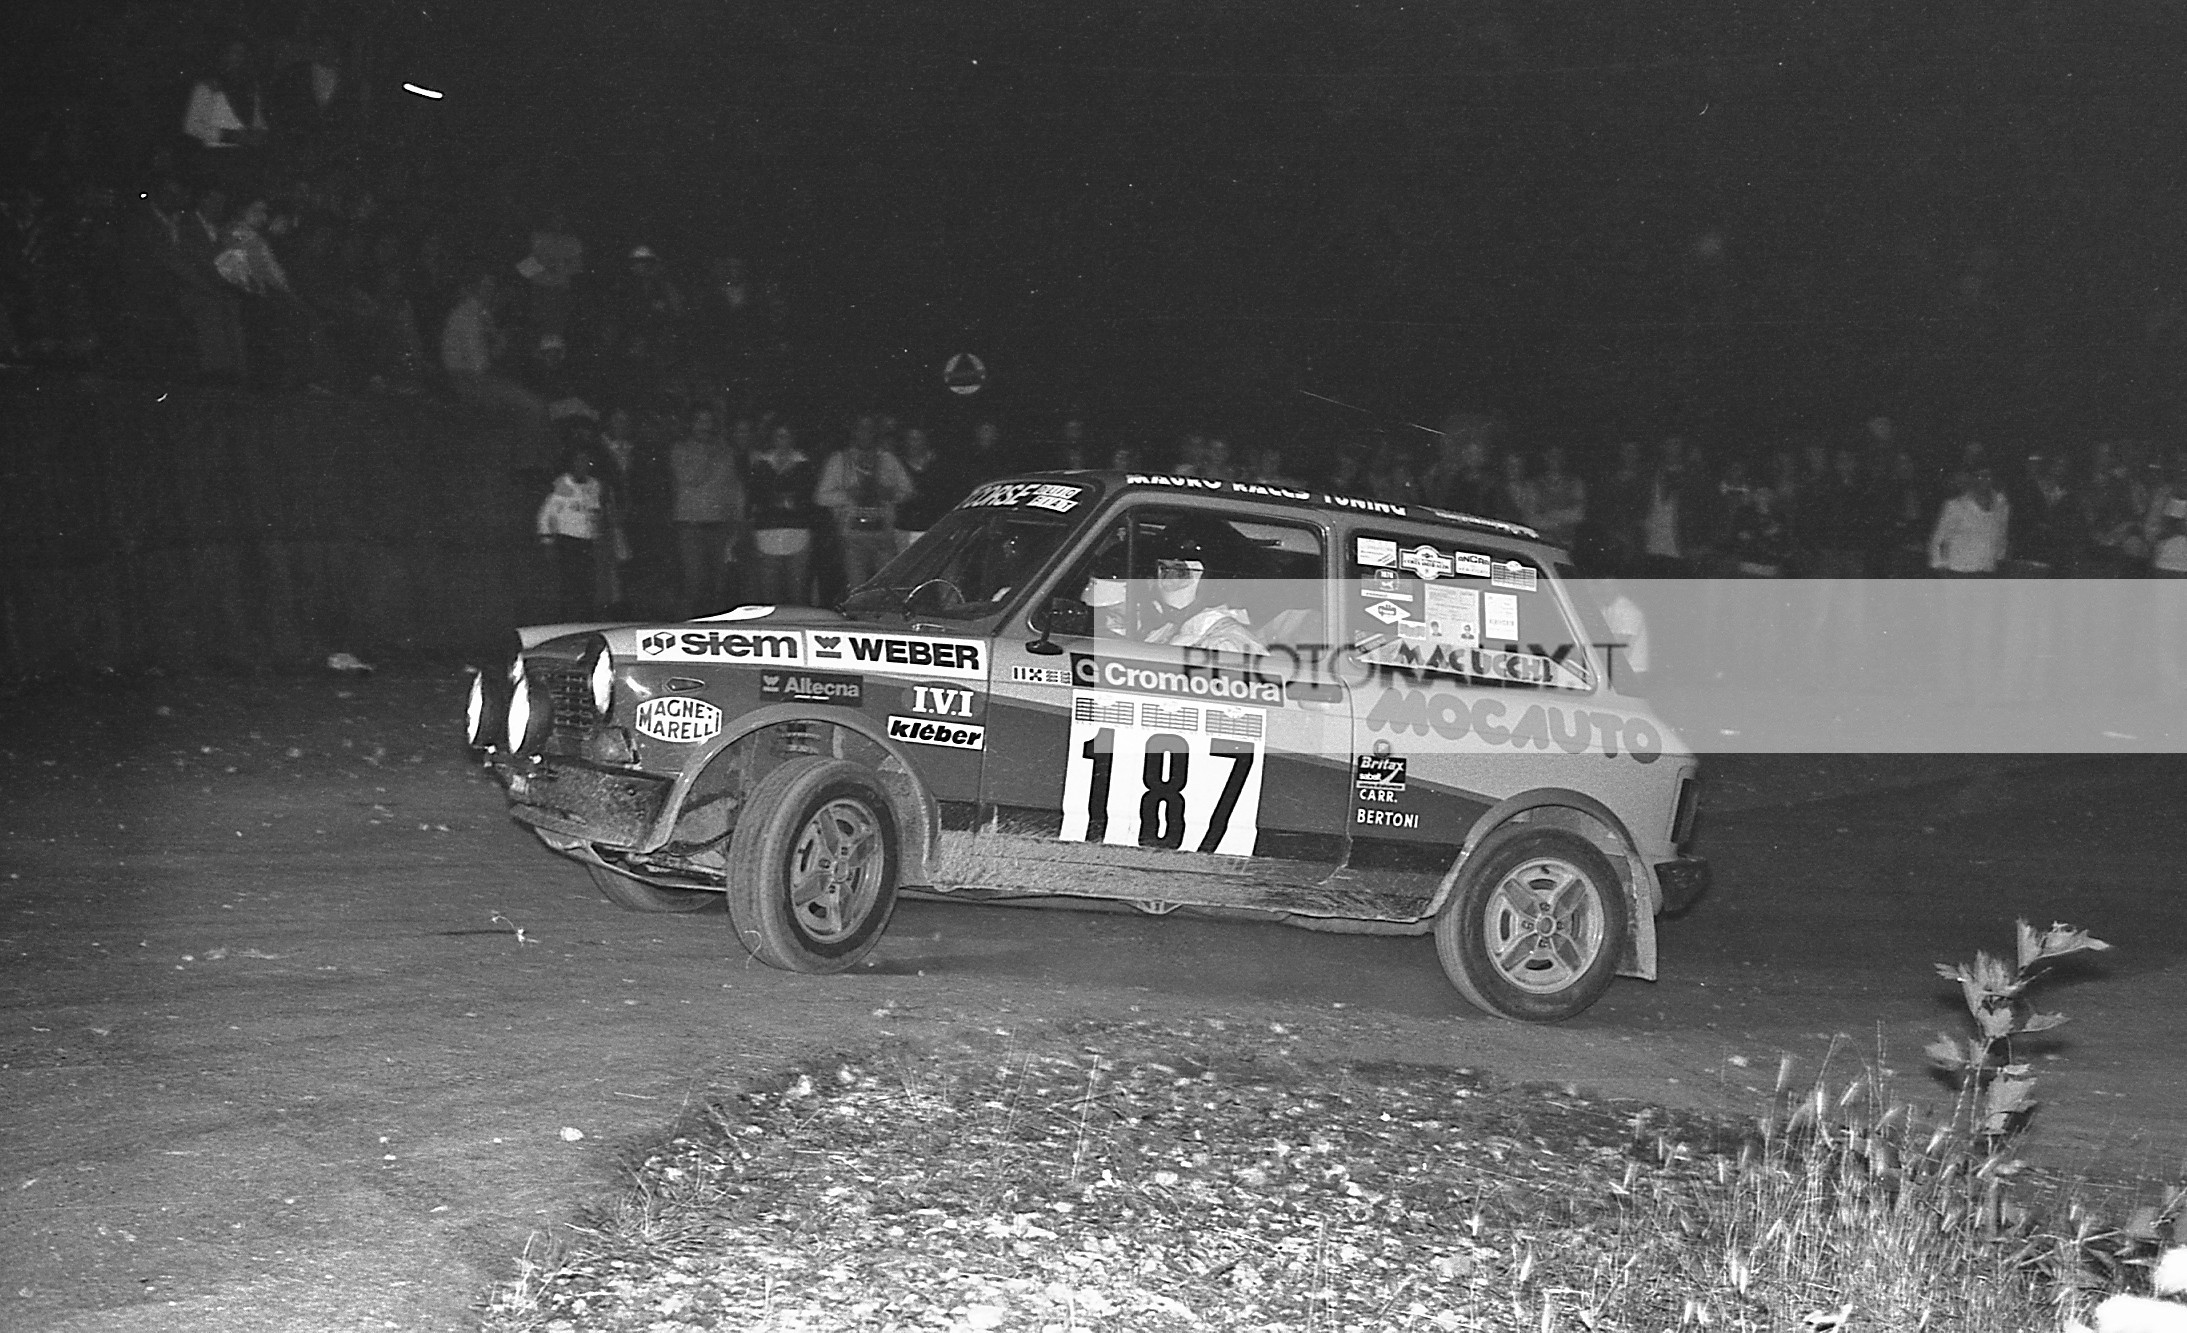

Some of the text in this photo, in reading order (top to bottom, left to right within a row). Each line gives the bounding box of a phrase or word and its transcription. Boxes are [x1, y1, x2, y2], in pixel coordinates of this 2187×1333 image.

[680, 632, 797, 658] siem
[849, 637, 981, 670] WEBER
[783, 676, 860, 698] Altecna
[1104, 662, 1281, 702] Cromodora
[640, 719, 719, 740] MARELLI
[890, 720, 982, 746] kléber
[1366, 687, 1663, 764] MOCAUTO
[1360, 756, 1404, 771] Britax
[1082, 727, 1255, 852] 187
[1359, 788, 1398, 803] CARR.
[1356, 808, 1419, 828] BERTONI
